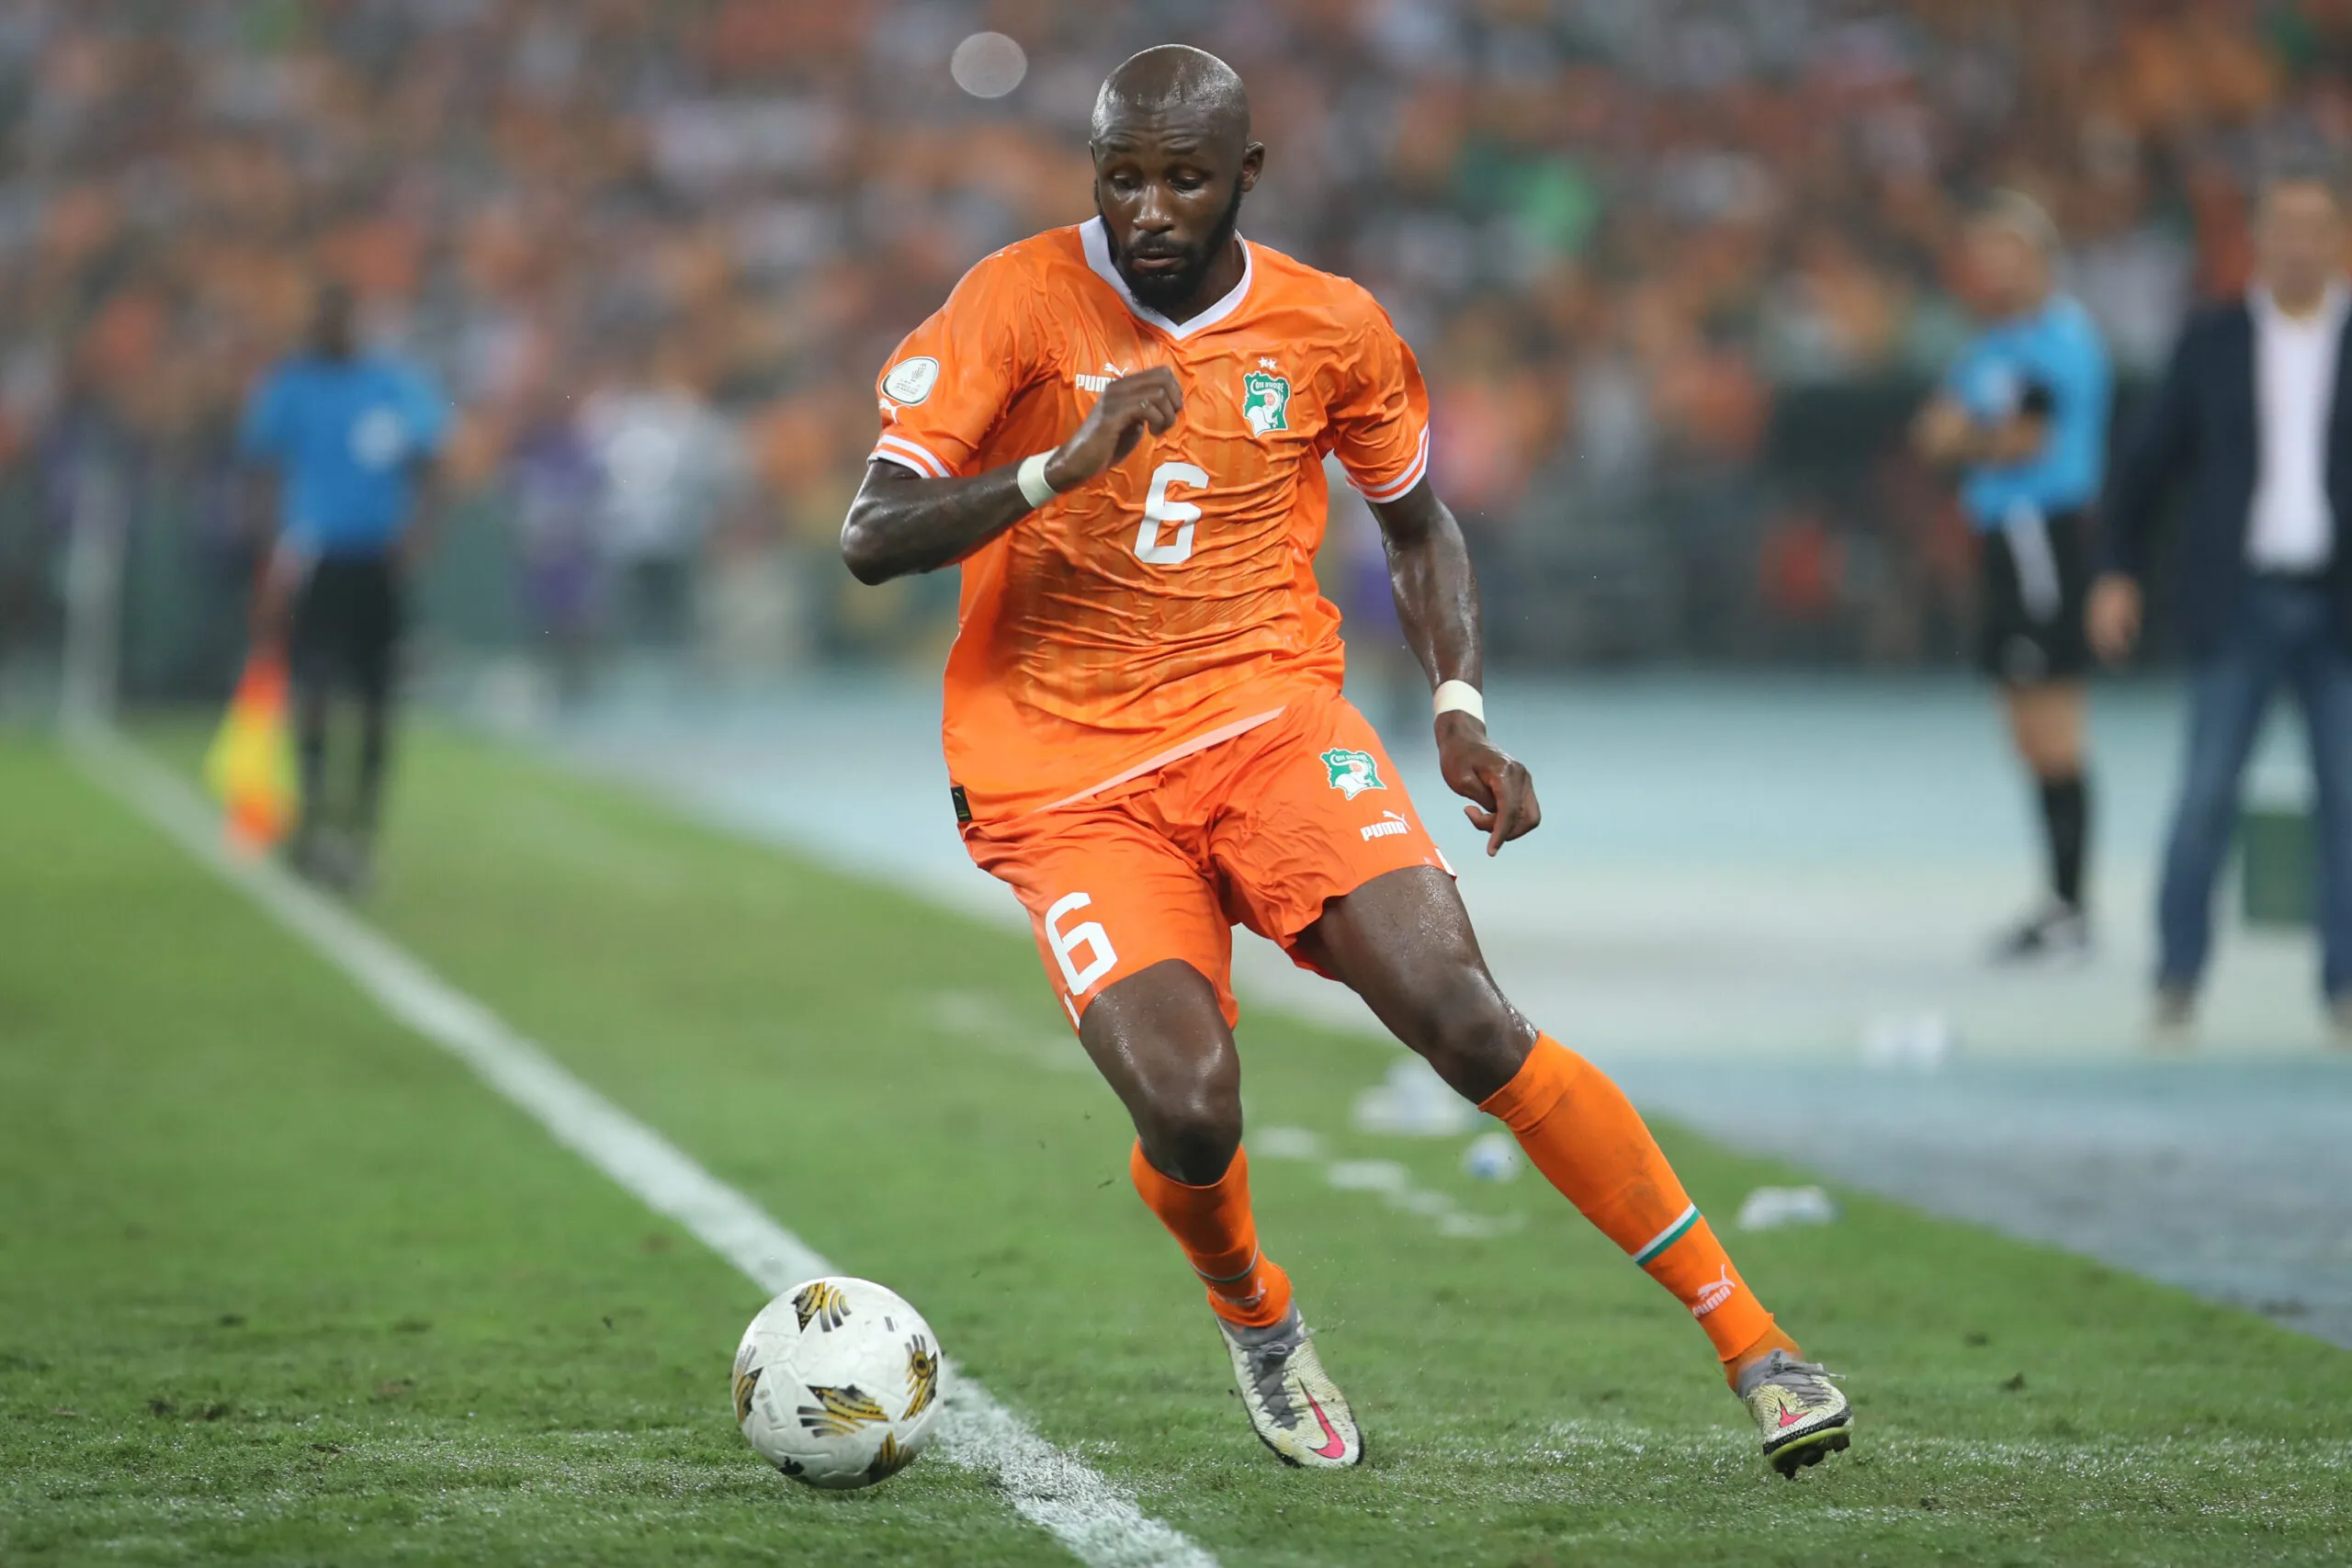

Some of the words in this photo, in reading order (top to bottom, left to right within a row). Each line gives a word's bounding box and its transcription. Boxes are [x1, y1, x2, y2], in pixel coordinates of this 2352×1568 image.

[1075, 374, 1118, 393] PUM
[1134, 461, 1210, 565] 6
[1360, 820, 1408, 841] PUMA
[1046, 891, 1118, 996] 6
[1692, 1285, 1731, 1317] PUMA
